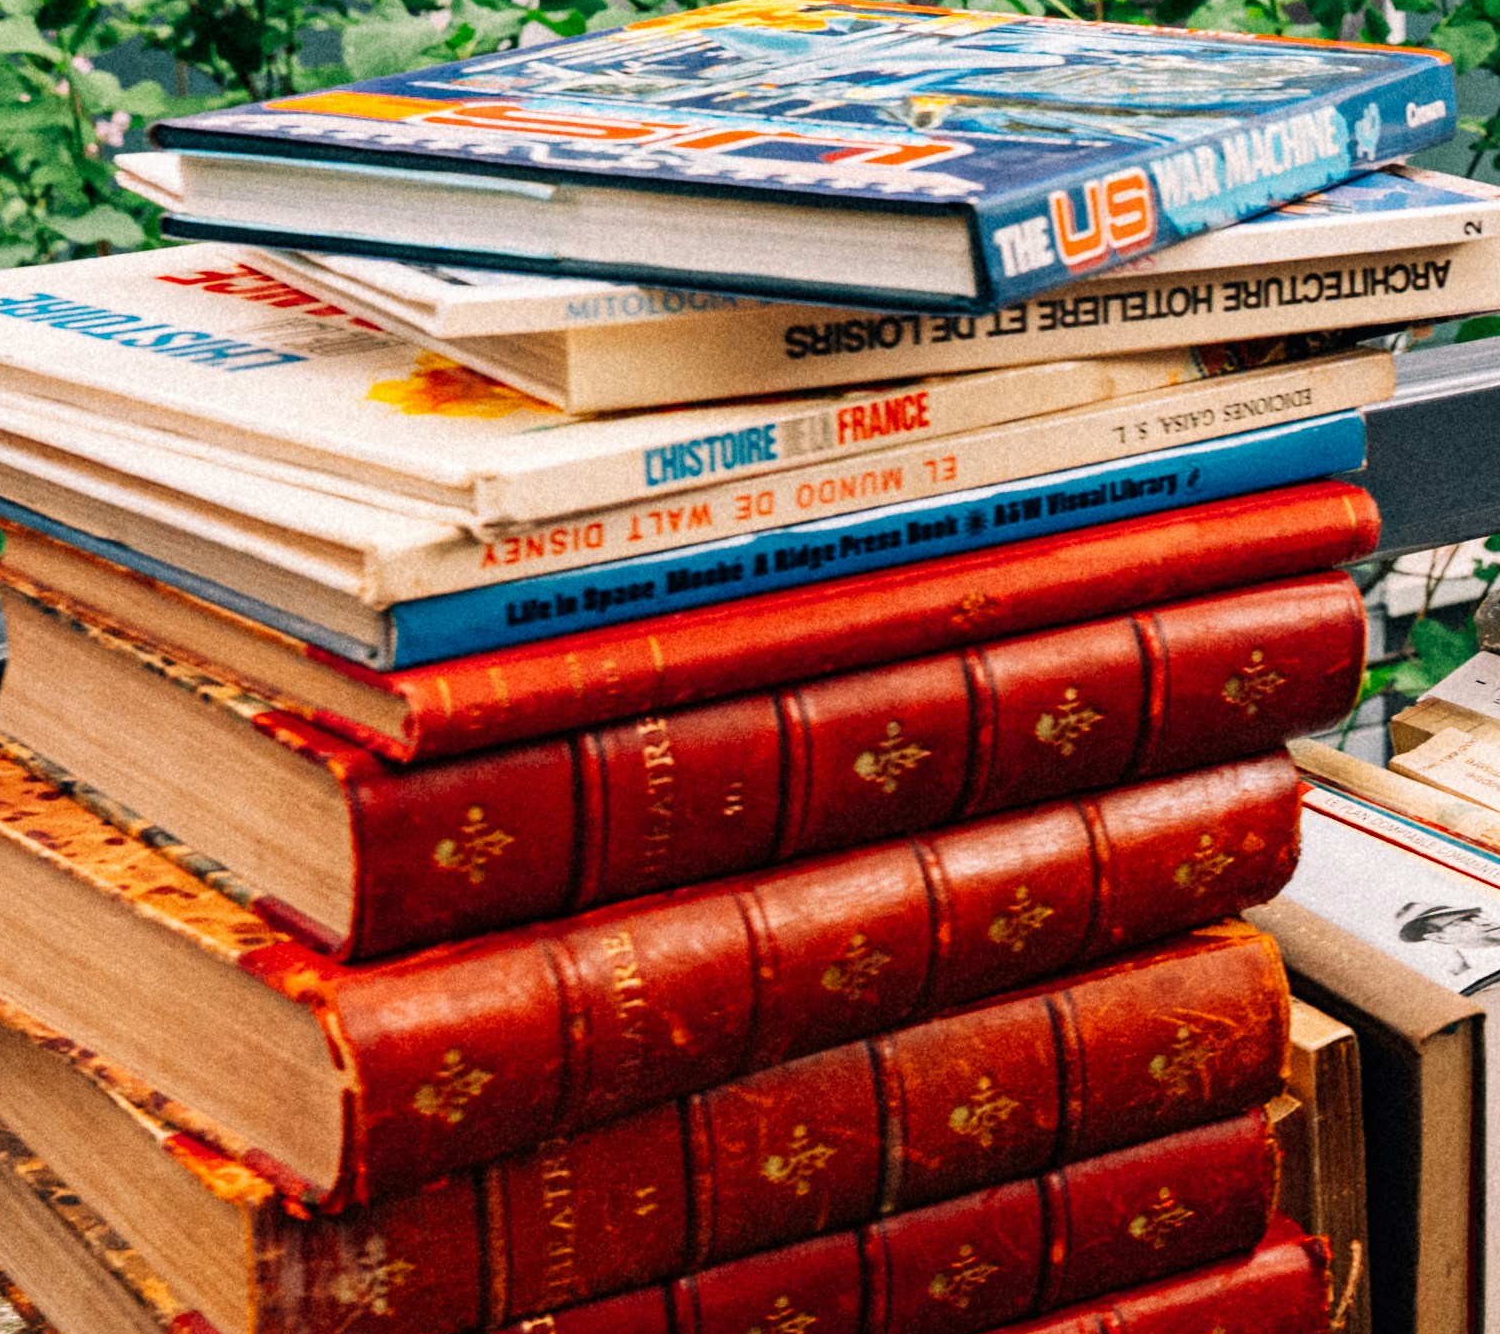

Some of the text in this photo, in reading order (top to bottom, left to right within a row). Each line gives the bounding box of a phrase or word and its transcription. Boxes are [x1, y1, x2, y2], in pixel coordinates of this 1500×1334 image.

[993, 105, 1343, 278] THE US WAR MACHINE
[1463, 219, 1483, 236] 2
[784, 259, 1453, 360] ARCHITECTURE HOTELIERE ET DE LOISIRS
[644, 423, 778, 487] L'HISTOIRE
[836, 392, 931, 445] FRANCE
[1224, 388, 1313, 423] EDICIONES
[480, 455, 958, 569] EL MUNDO DE WALT DISNEY
[506, 596, 551, 627] Life
[555, 591, 580, 618] in
[583, 578, 656, 613] Space
[773, 535, 836, 571] Ridge
[838, 525, 902, 564] Press
[905, 512, 959, 548] Book
[1046, 481, 1109, 517] Visual
[1109, 470, 1180, 505] Library
[1323, 796, 1339, 808] LE
[1340, 802, 1369, 822] PLAN
[1369, 816, 1441, 851] COMPTABLE
